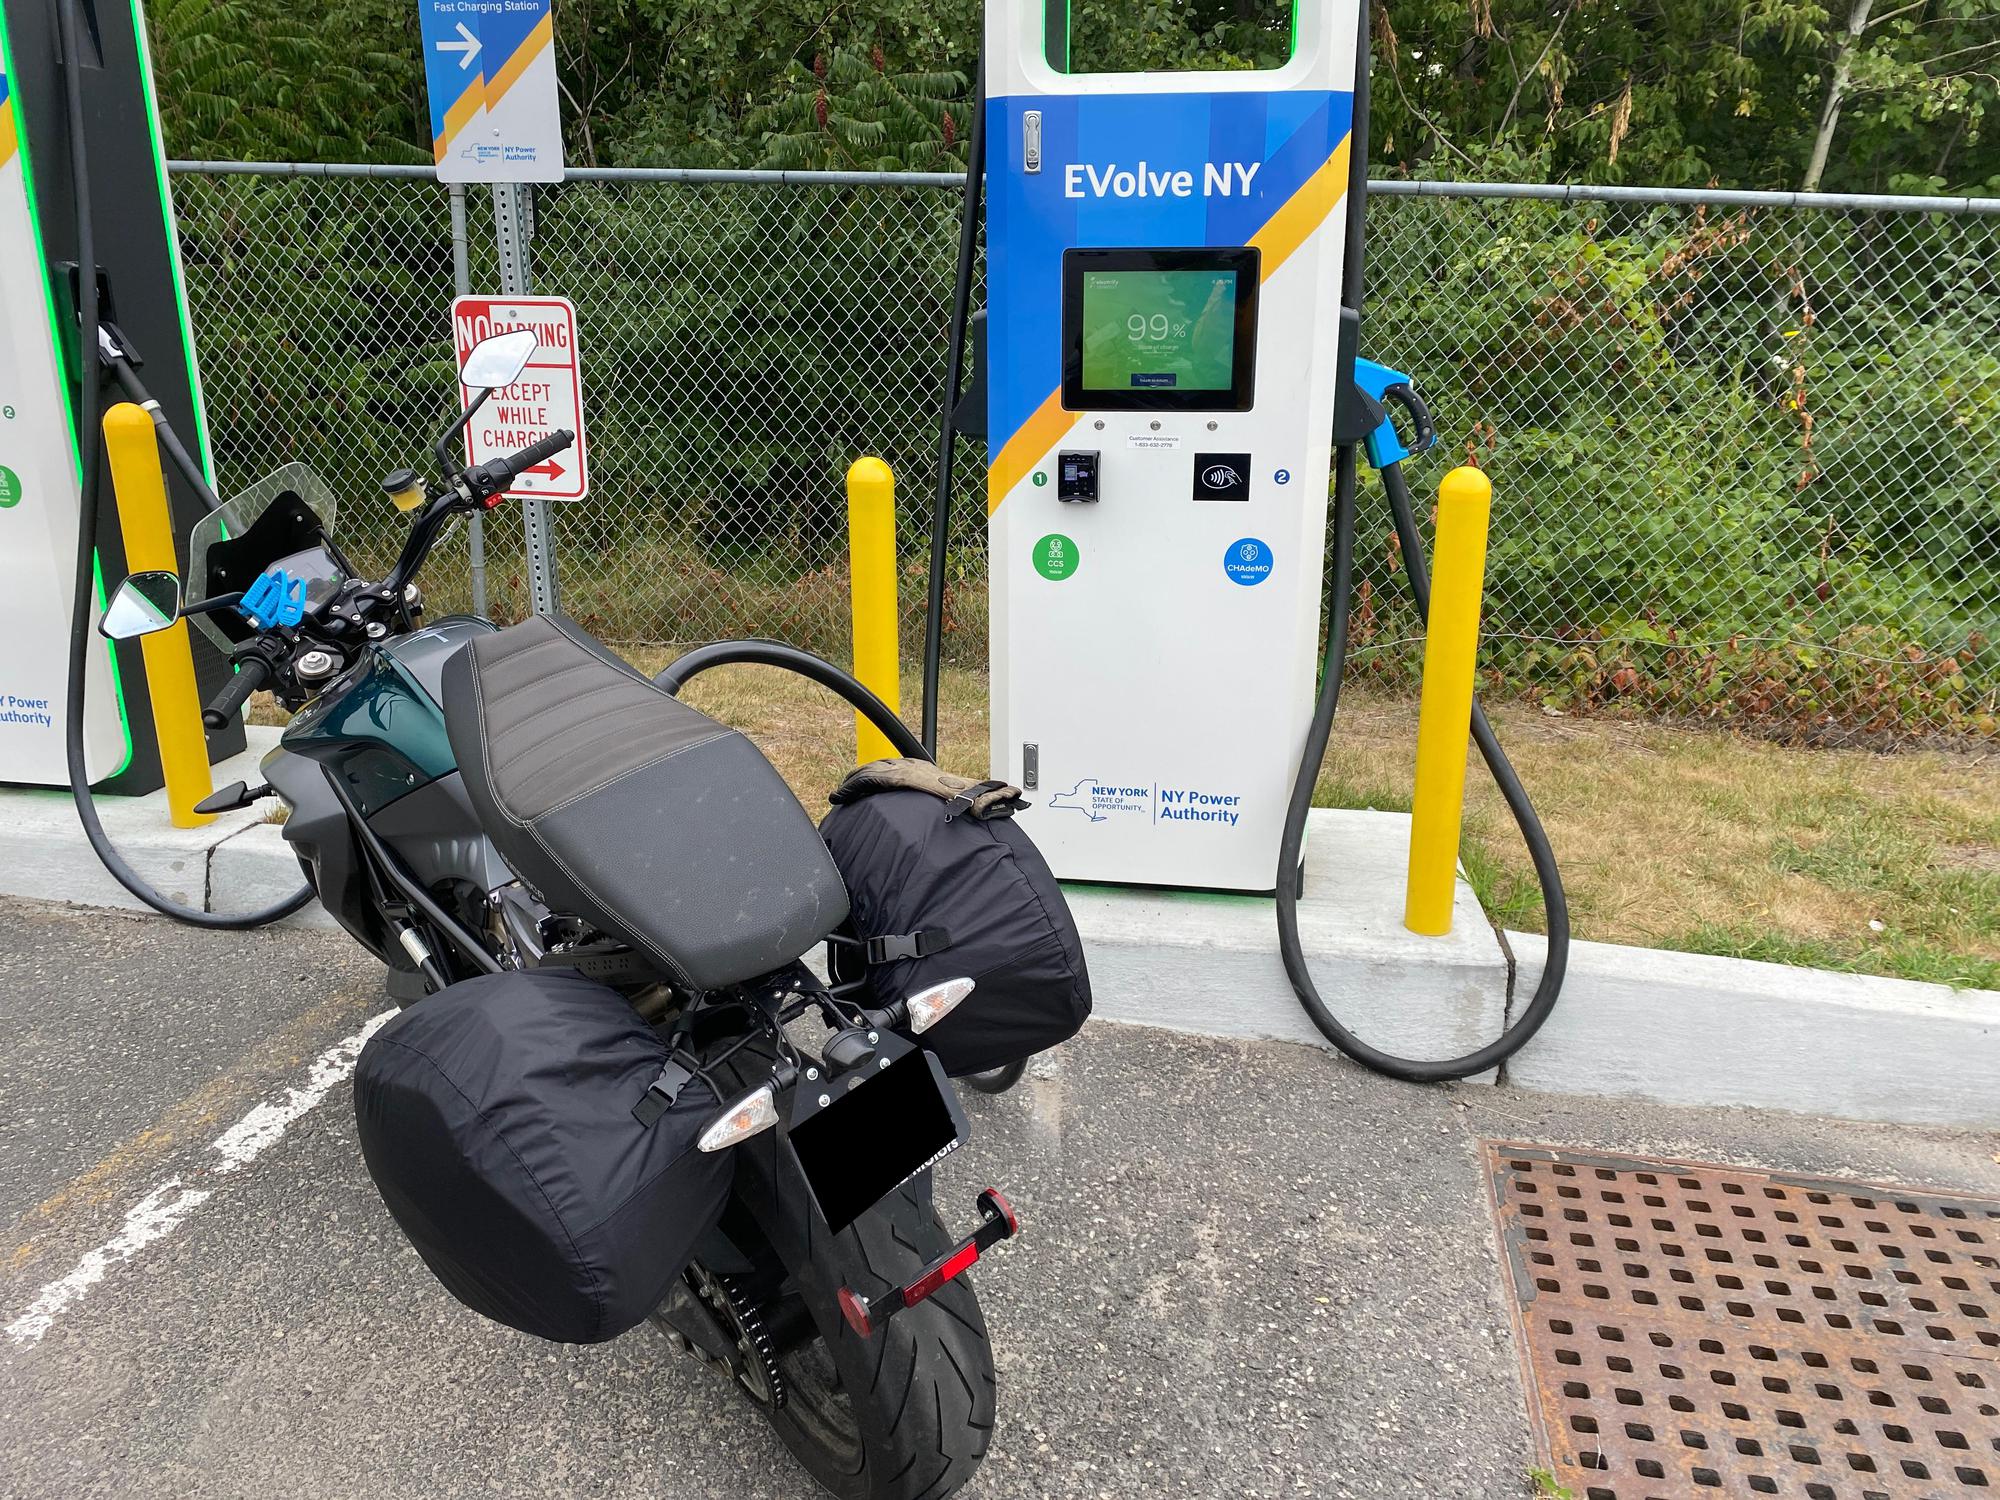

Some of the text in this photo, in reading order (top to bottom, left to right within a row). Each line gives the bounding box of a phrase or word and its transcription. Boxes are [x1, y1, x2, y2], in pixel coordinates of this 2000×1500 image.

[434, 1, 539, 13] Fast Charging Station
[505, 154, 537, 162] Authority
[1065, 161, 1261, 198] EVolve NY
[5, 407, 13, 417] 2
[497, 406, 548, 425] WHILE
[1277, 471, 1287, 483] 2
[1227, 564, 1270, 573] CHAdeMO
[8, 695, 48, 709] Power
[0, 710, 51, 728] uthority
[1092, 786, 1149, 797] NEW YORK
[1161, 789, 1240, 806] NY Power
[1092, 803, 1142, 811] OPPORTUNITY
[1160, 806, 1239, 827] Authority
